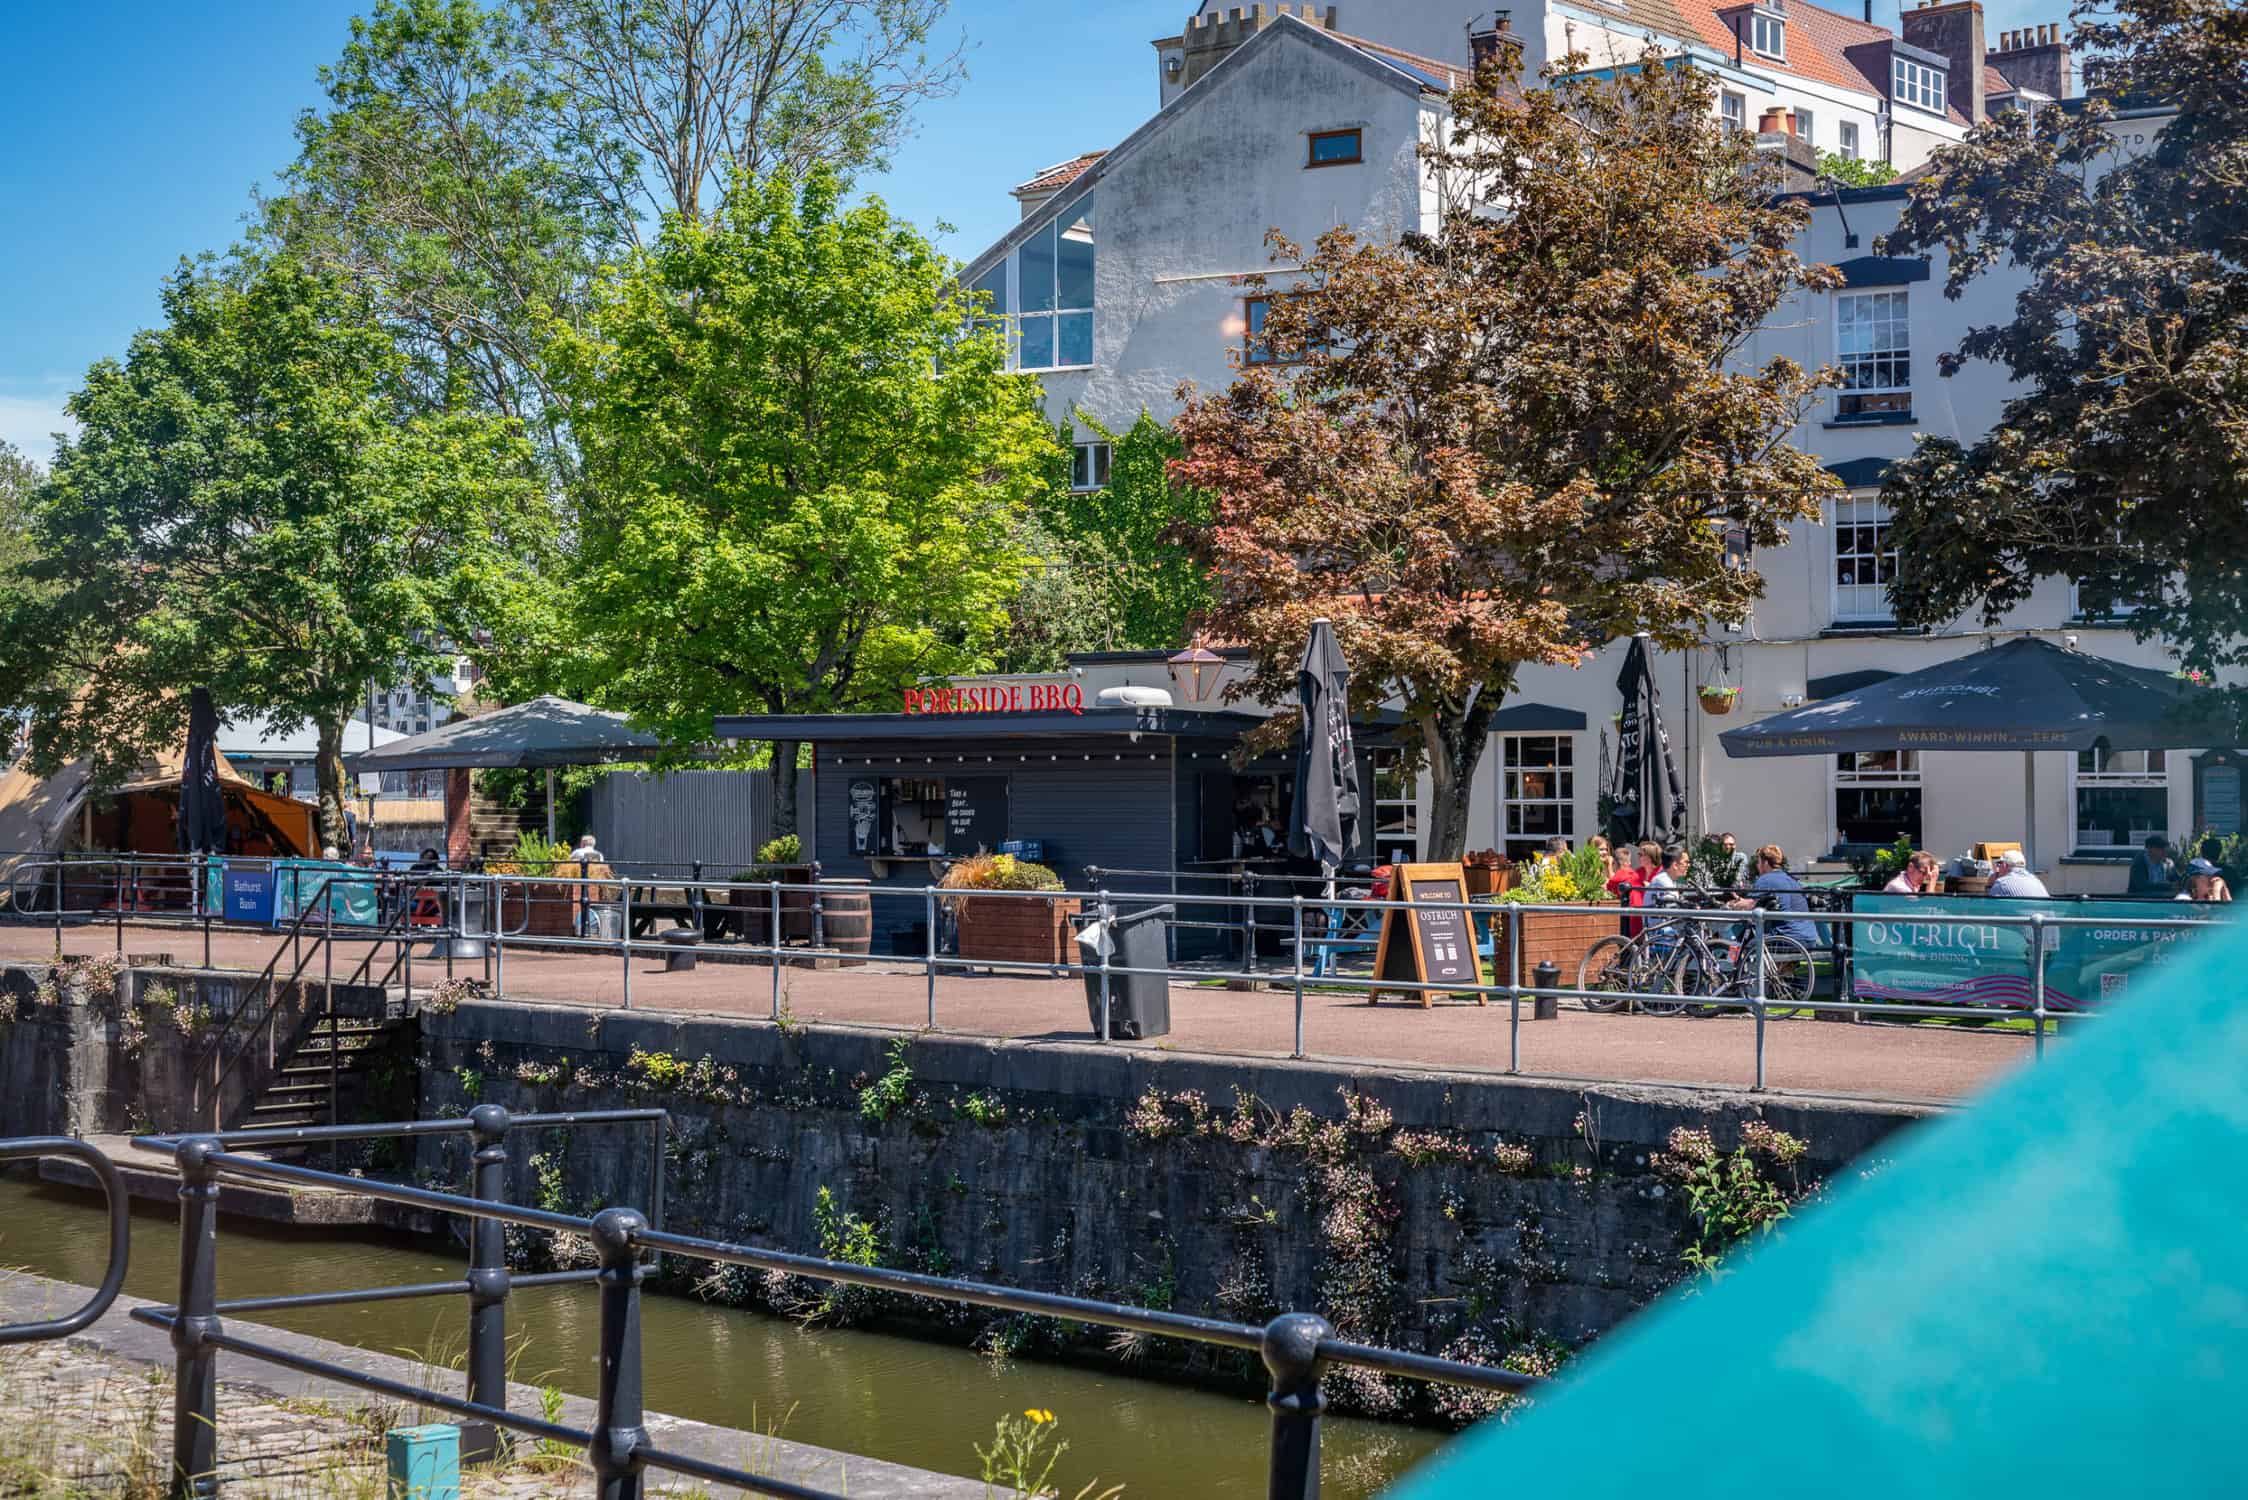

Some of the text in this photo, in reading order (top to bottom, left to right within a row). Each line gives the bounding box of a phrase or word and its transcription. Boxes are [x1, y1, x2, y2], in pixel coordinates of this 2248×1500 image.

[903, 683, 1088, 716] PORTSIDE BBQ
[233, 880, 262, 893] Bathurst
[239, 898, 257, 910] Basin
[1420, 910, 1457, 921] OSTRICH
[1867, 921, 2001, 950] OSTRICH
[2093, 930, 2137, 941] ORDER
[2140, 930, 2149, 942] &
[2152, 929, 2177, 943] PAY
[1930, 952, 1969, 963] DINING
